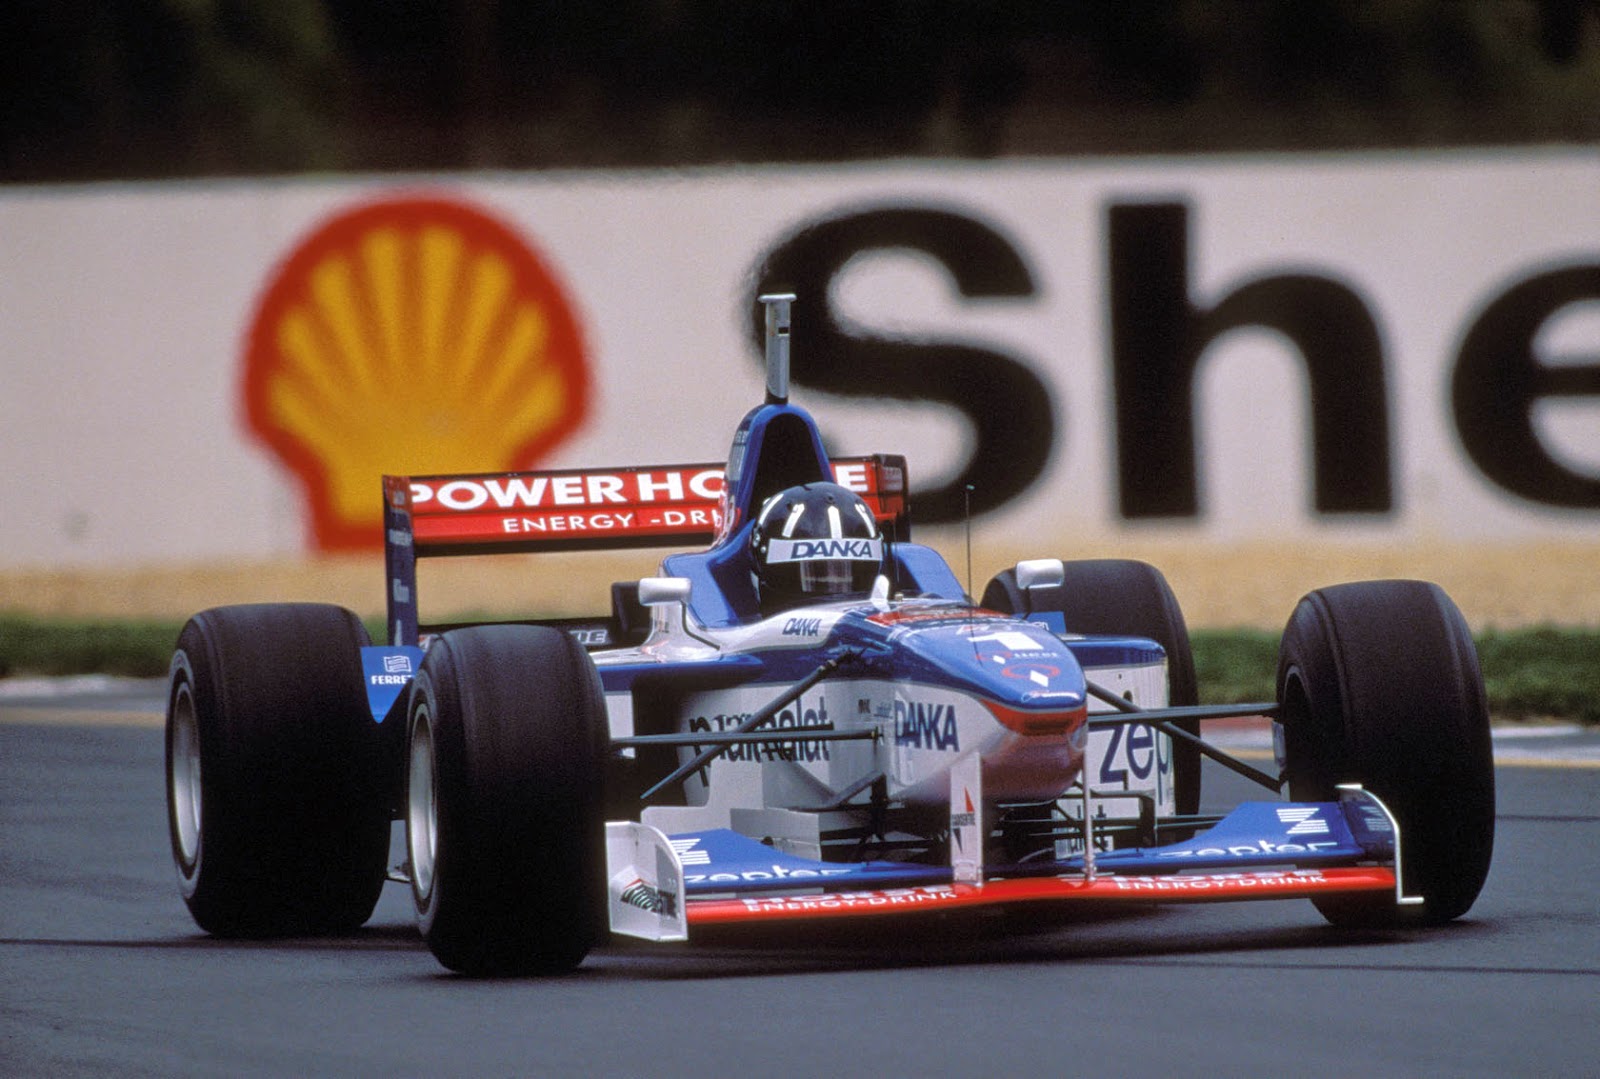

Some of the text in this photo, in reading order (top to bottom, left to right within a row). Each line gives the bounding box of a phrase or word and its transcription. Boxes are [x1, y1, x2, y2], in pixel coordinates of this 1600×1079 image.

[409, 474, 629, 511] POWER
[502, 507, 633, 534] ENERGY
[791, 540, 873, 559] DANKA
[782, 618, 823, 637] DANKA
[371, 675, 414, 686] FERRE
[894, 700, 960, 753] DANKA
